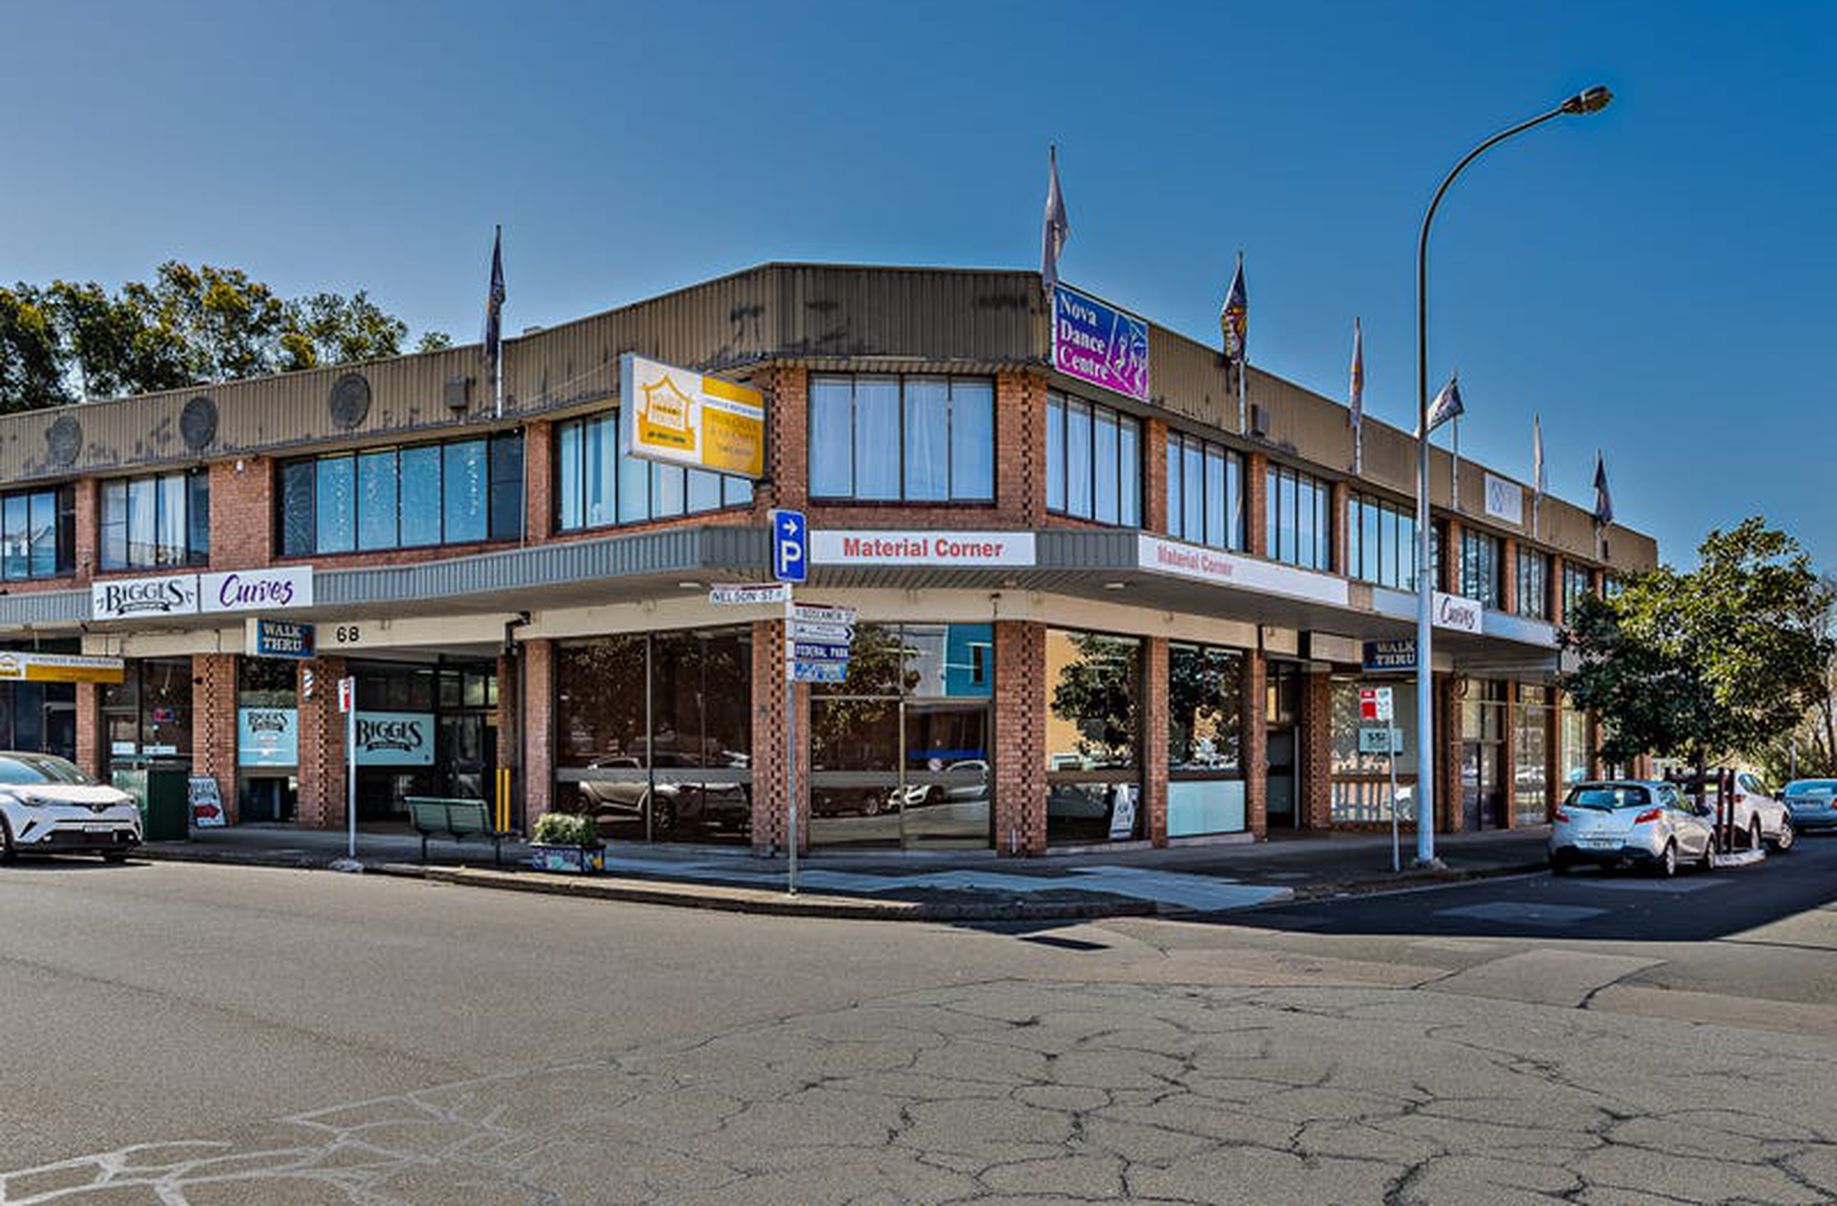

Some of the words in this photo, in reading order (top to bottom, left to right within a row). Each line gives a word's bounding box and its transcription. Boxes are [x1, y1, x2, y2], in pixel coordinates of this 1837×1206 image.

[1059, 292, 1097, 327] Nova
[1060, 319, 1107, 354] Dance
[1060, 345, 1110, 380] Centre
[781, 540, 802, 573] P
[843, 537, 928, 558] Material
[935, 538, 1004, 558] Corner
[1157, 542, 1199, 570] Material
[1200, 552, 1234, 576] Corner
[219, 573, 294, 607] Curves
[1440, 597, 1476, 629] Curves
[263, 622, 301, 637] WALK
[263, 637, 302, 652] THRU
[336, 626, 360, 643] 68
[1376, 641, 1415, 652] WALK
[1376, 652, 1415, 666] THRU
